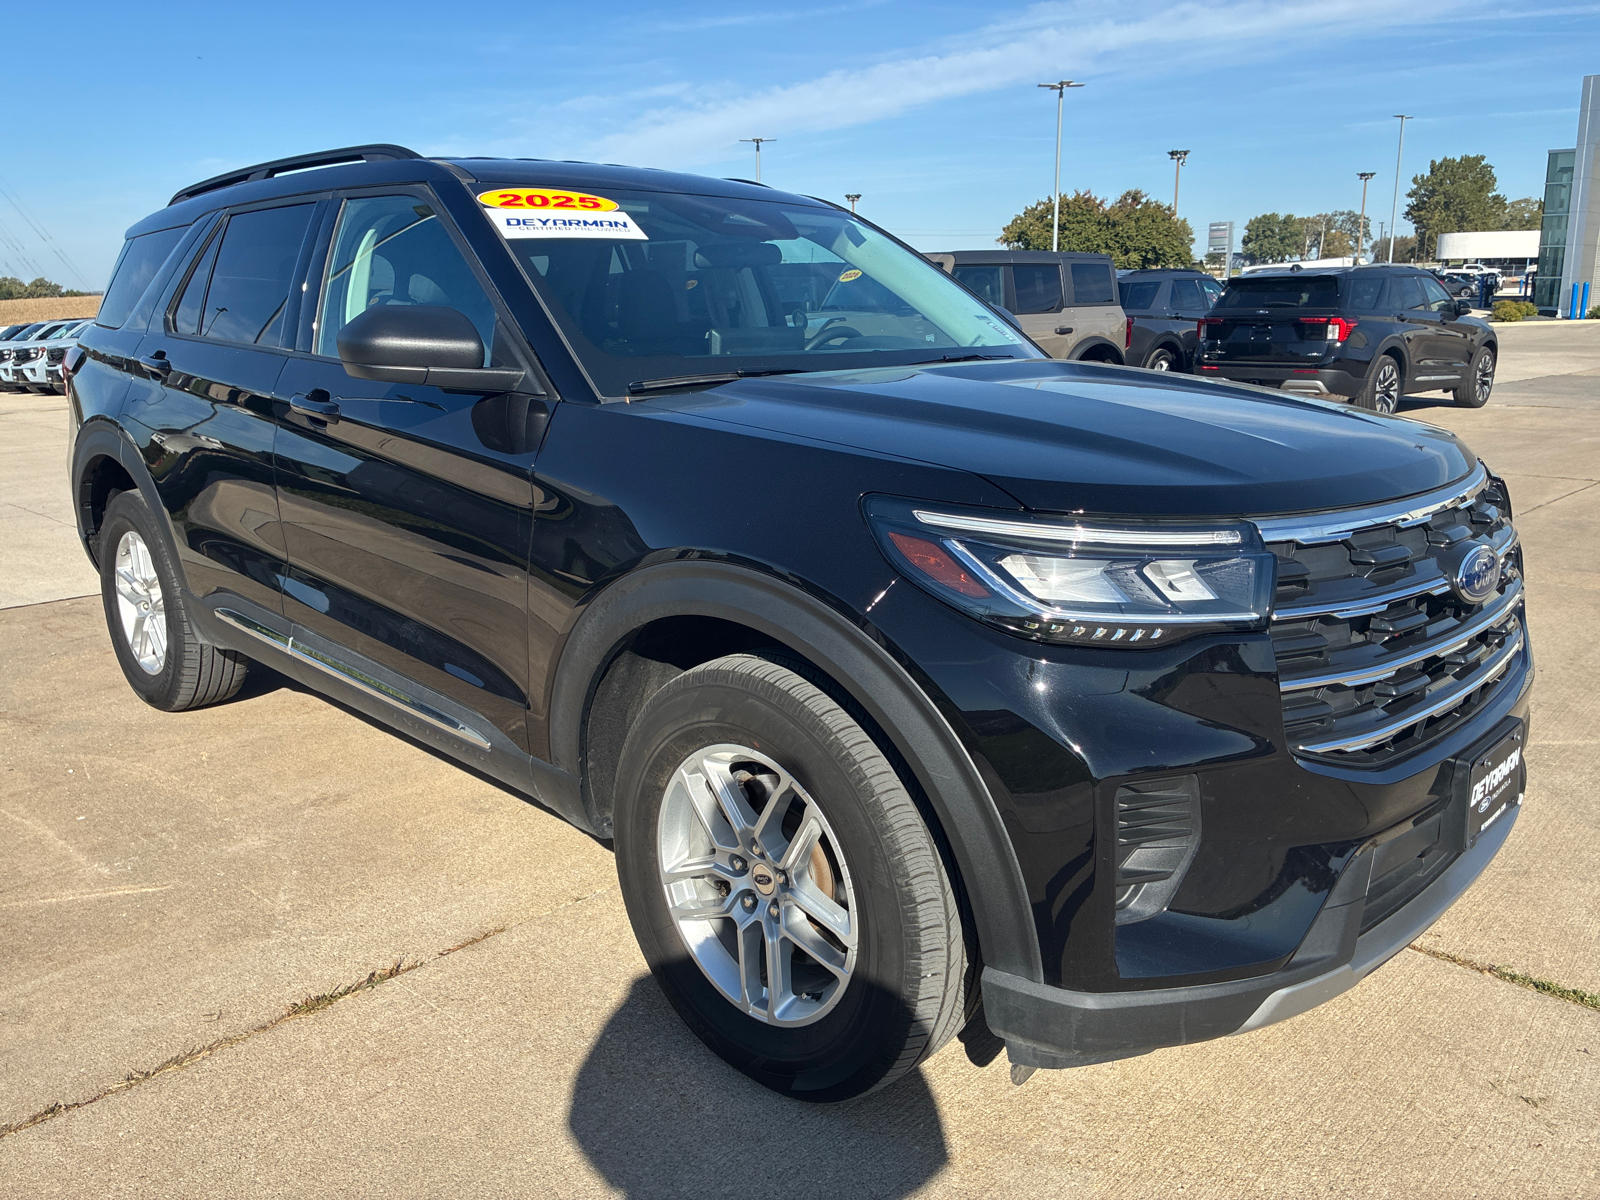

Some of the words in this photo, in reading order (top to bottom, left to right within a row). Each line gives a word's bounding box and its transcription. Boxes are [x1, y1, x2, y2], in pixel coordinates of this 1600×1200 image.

[498, 193, 602, 209] 2025
[506, 218, 628, 228] DEYARMAN
[1470, 746, 1520, 808] DEYARMAN
